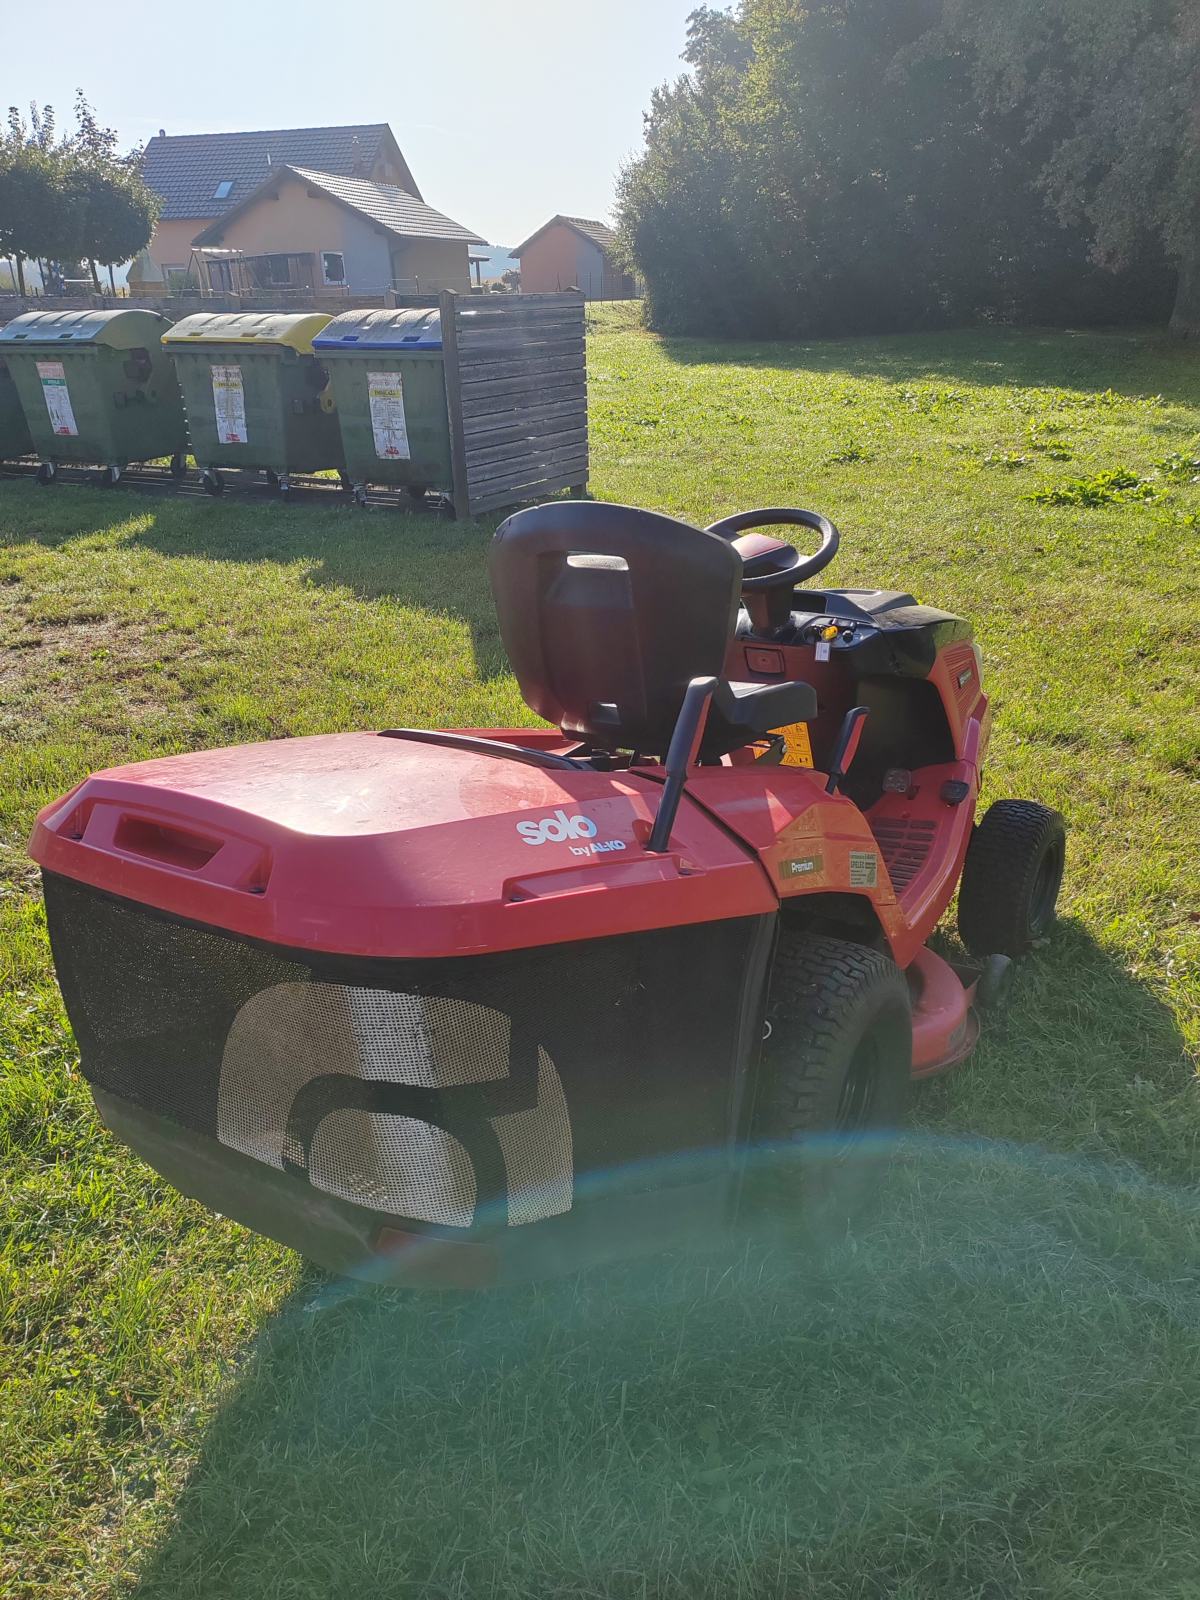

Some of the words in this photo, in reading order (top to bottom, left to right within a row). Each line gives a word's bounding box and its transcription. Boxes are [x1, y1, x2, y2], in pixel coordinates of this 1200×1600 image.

[516, 810, 597, 846] solo
[569, 846, 591, 857] by
[791, 861, 814, 874] Premium
